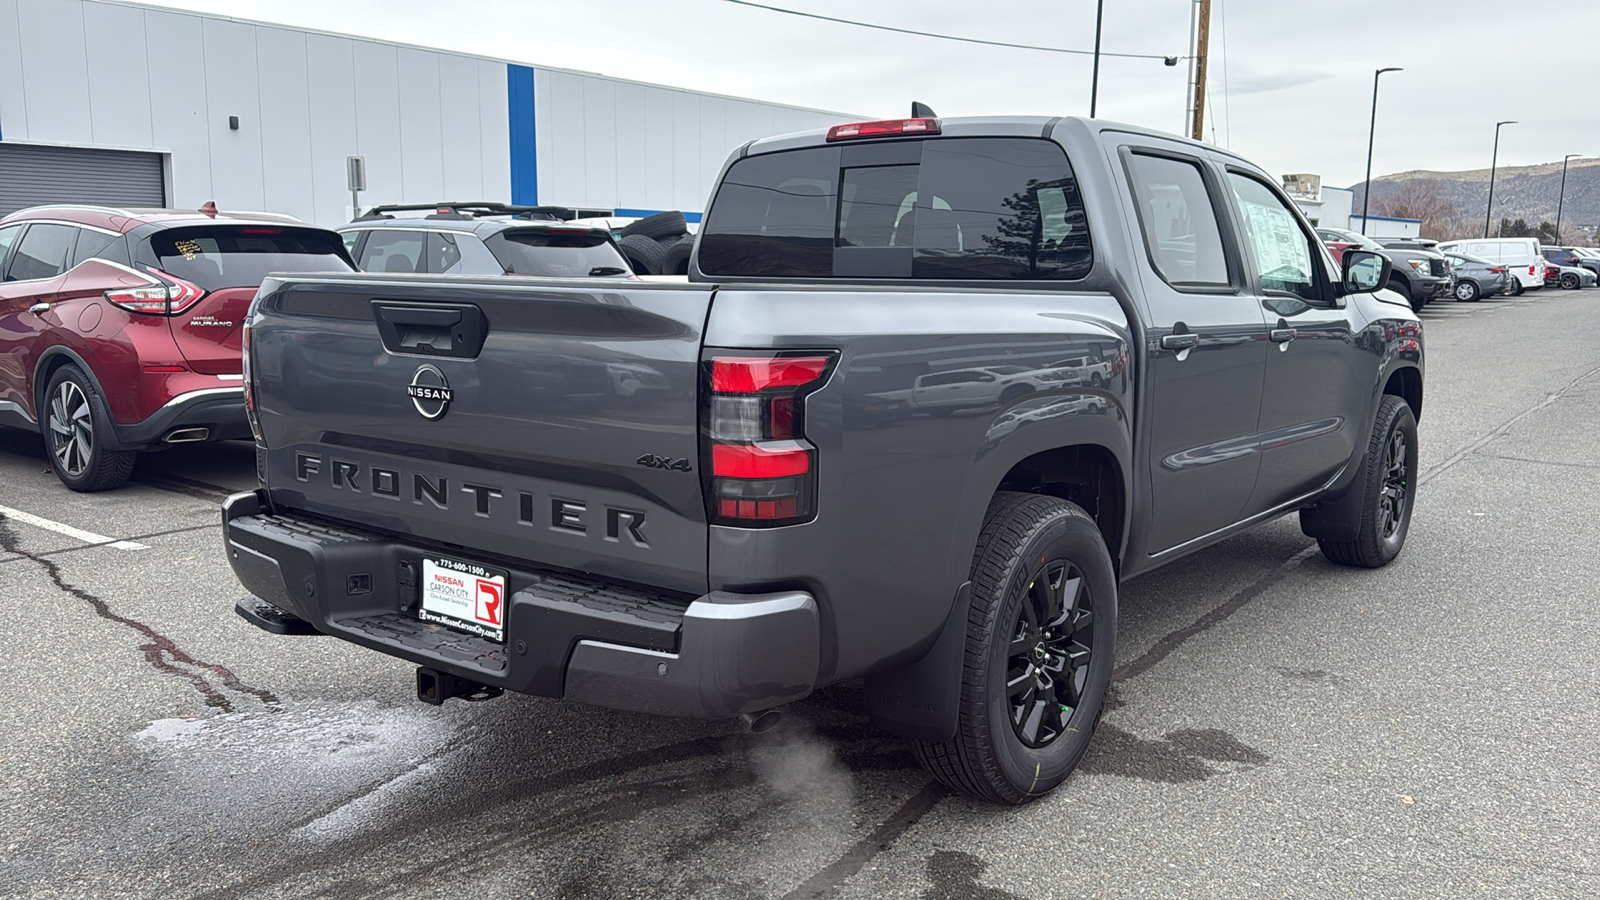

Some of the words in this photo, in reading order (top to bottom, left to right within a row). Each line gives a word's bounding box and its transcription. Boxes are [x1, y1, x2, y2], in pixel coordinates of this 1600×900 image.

[407, 386, 450, 400] NISSAN
[295, 450, 650, 549] FRONTIER
[440, 559, 485, 576] 775-600-1500
[434, 574, 464, 588] NISSAN
[430, 582, 455, 595] CARSON
[456, 588, 469, 598] CITY
[426, 614, 497, 638] www.NissanCarsonCity.com
